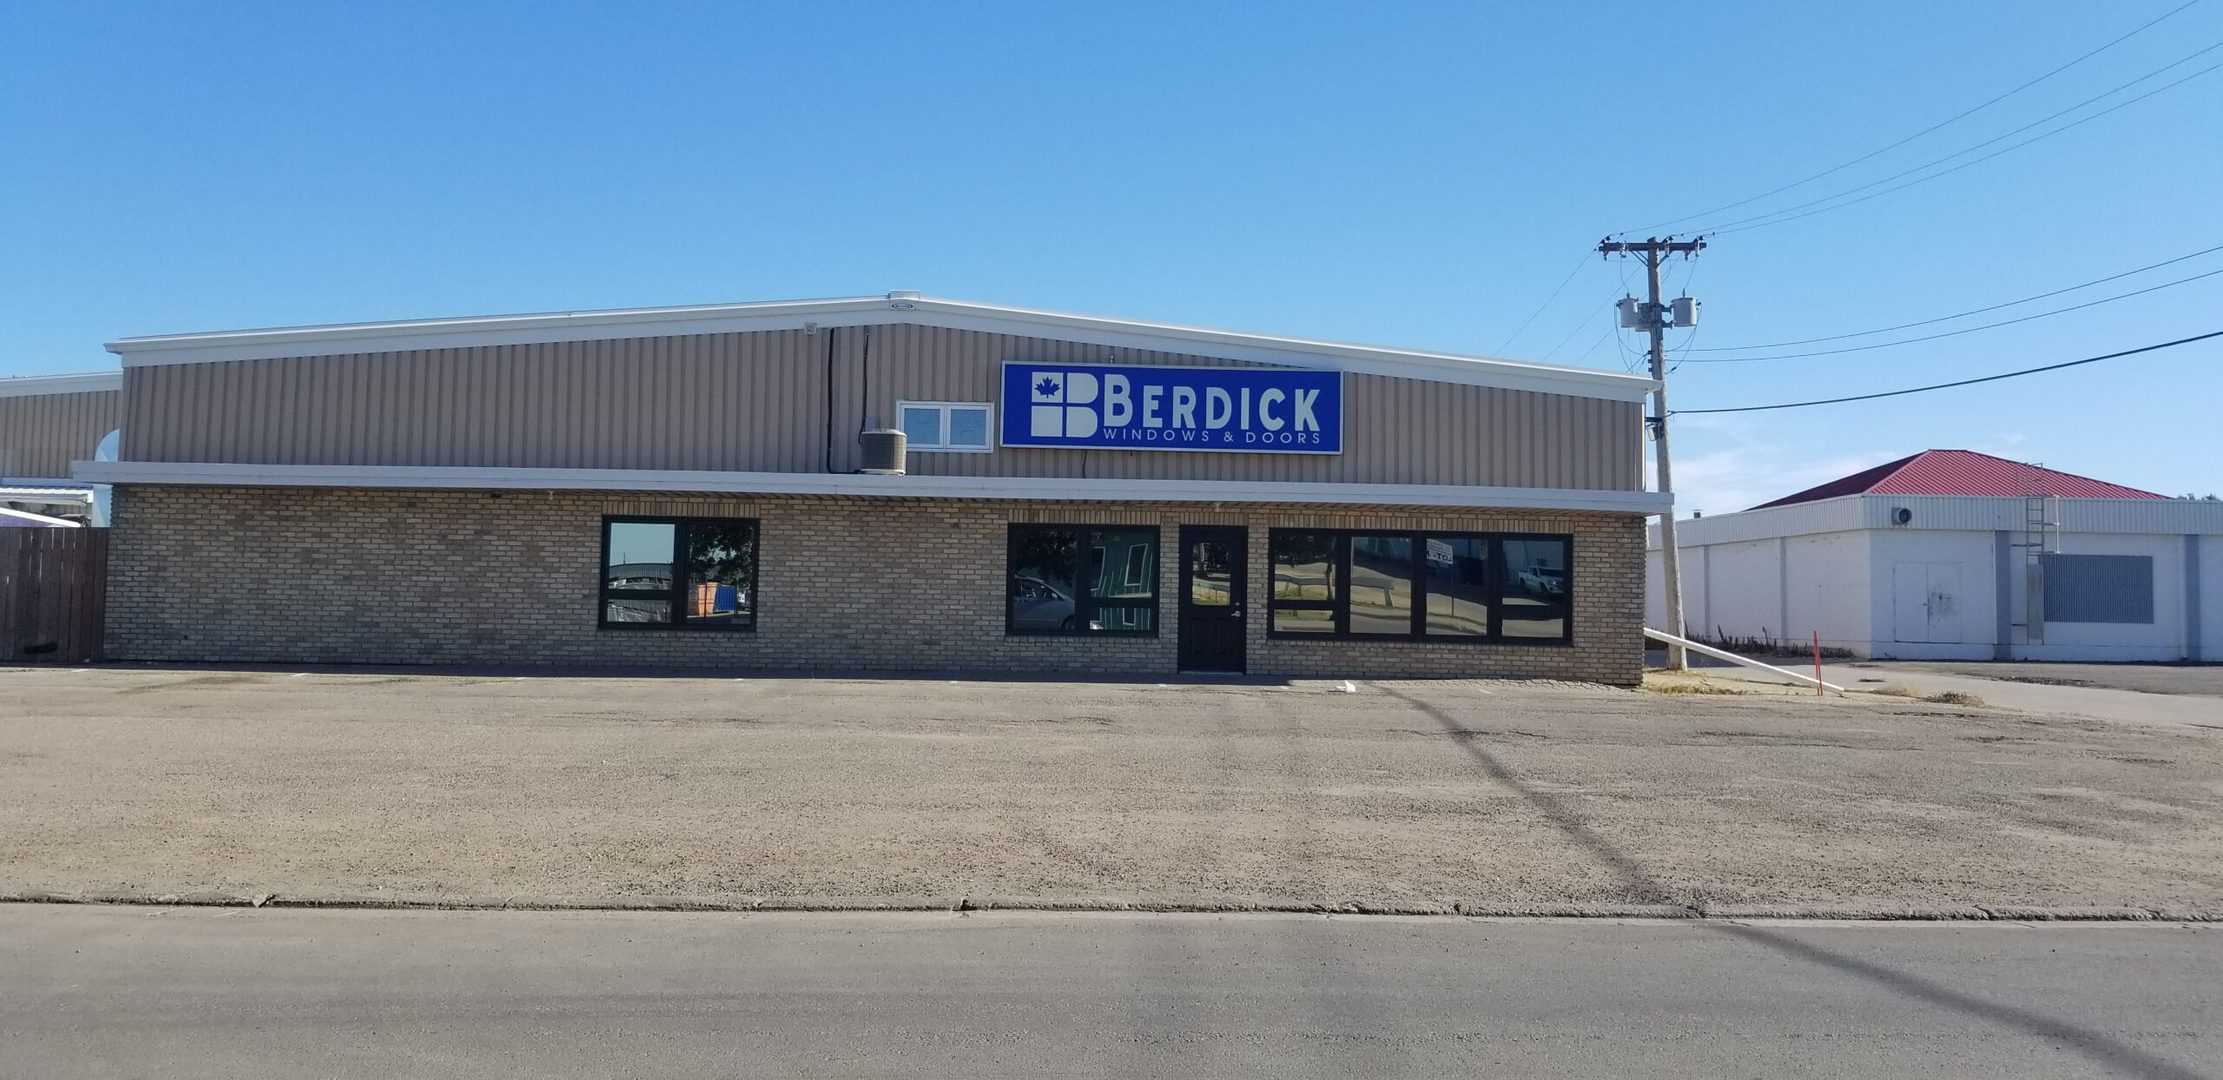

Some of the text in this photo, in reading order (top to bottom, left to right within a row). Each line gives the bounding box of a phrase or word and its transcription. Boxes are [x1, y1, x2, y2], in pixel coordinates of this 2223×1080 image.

[1103, 373, 1321, 432] BERDICK
[1103, 428, 1320, 444] WINDOWS & DOORS
